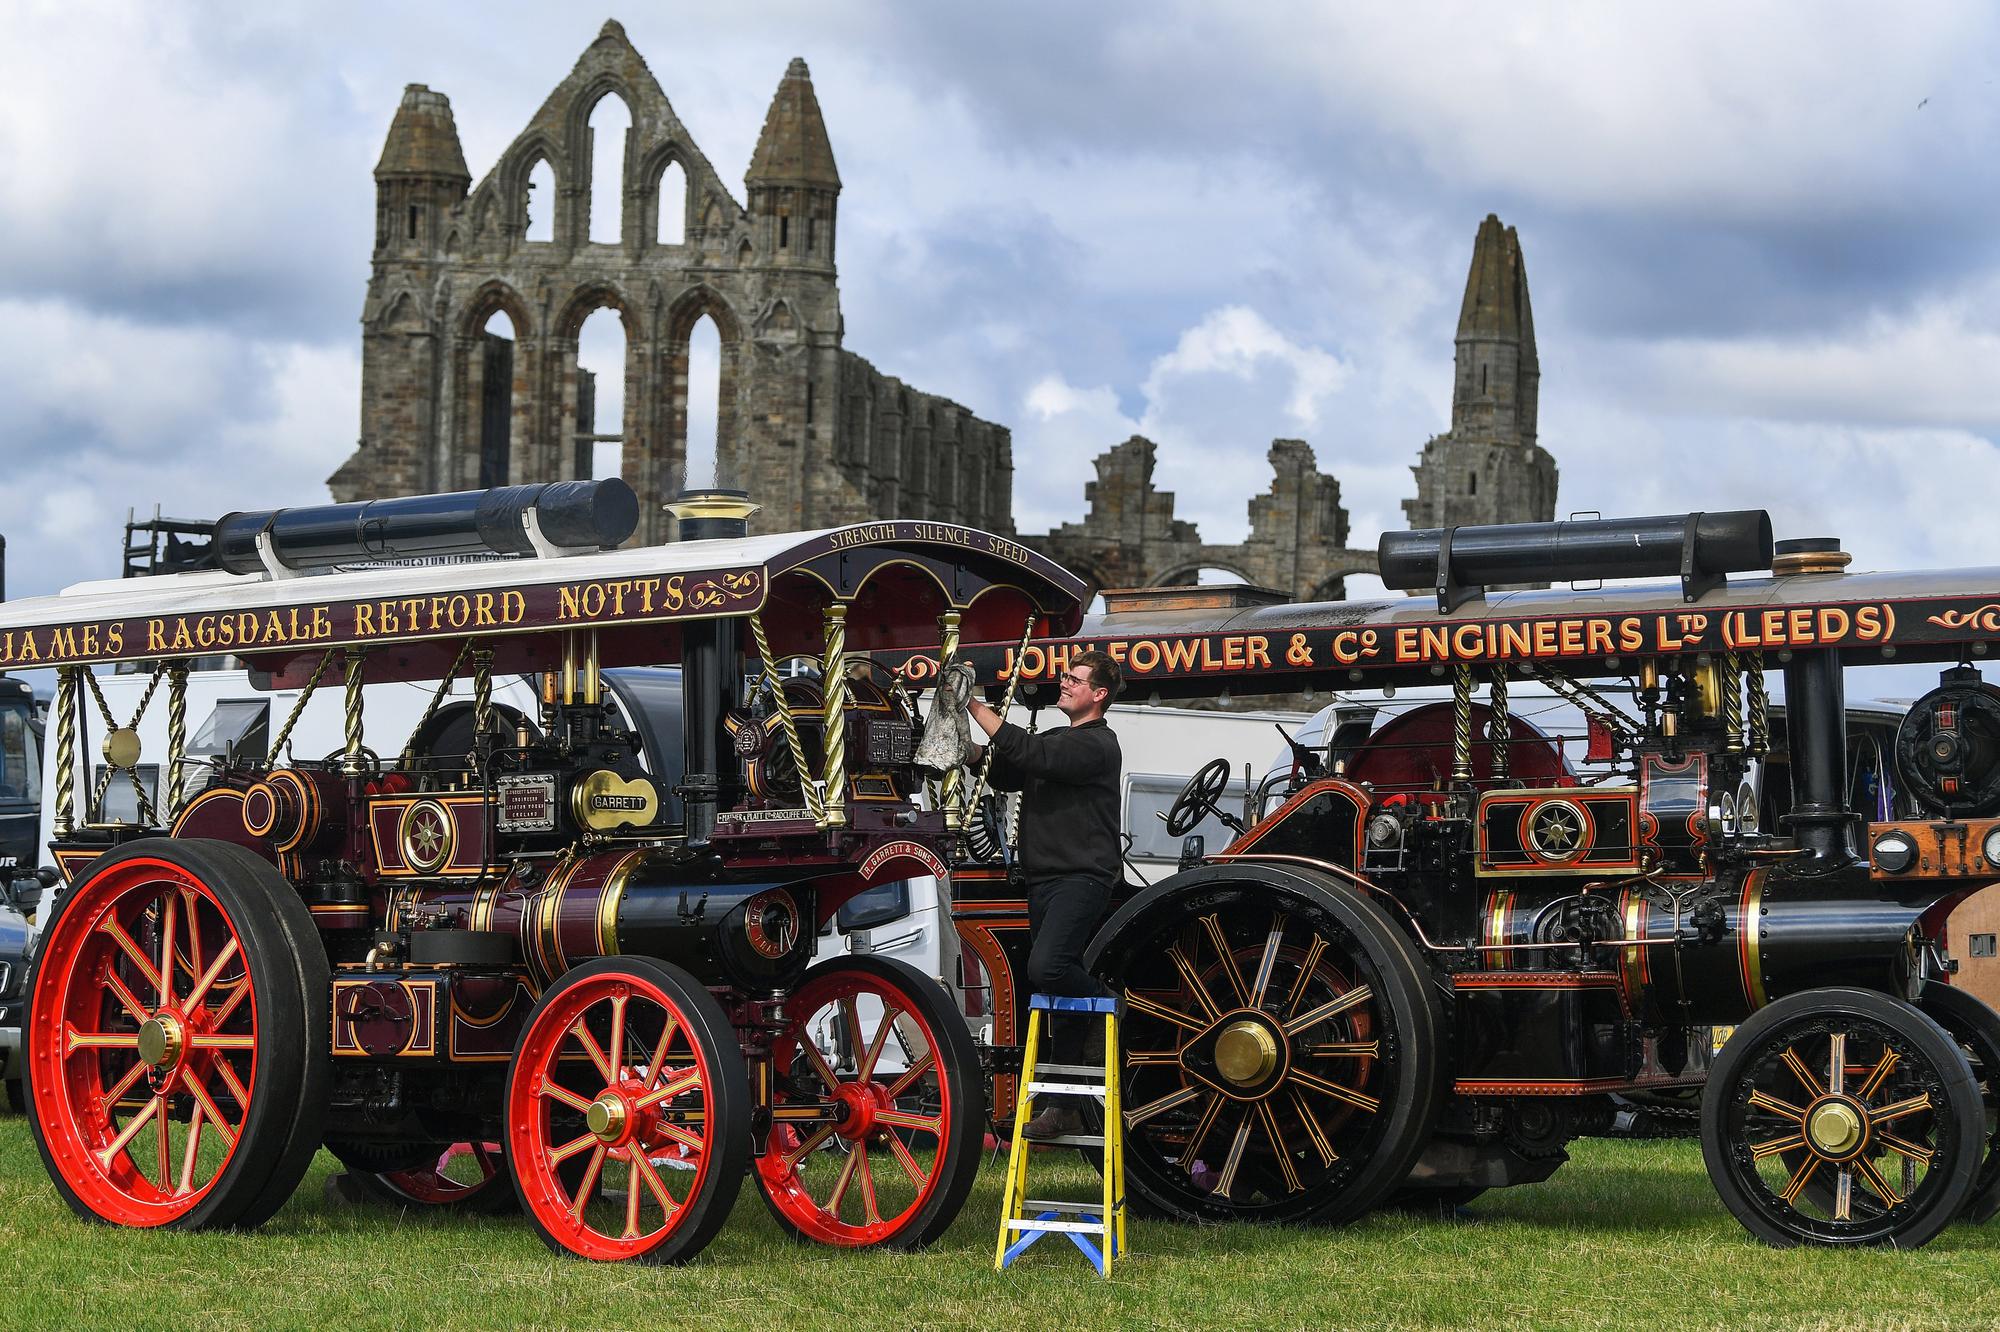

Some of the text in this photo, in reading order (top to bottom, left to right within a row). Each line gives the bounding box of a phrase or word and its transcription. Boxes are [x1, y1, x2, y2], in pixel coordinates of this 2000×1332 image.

[829, 524, 1029, 564] STRENGTH SILENCE SPEED
[0, 576, 685, 662] JAMES RAGSDALE RETFORD NOTTS
[997, 643, 1095, 681] JOH
[1108, 636, 1272, 673] FOWLER
[1285, 633, 1314, 667] &
[1395, 617, 1644, 663] ENGINEERS
[1721, 604, 1896, 649] (LEEDS)
[595, 796, 644, 809] GARRETT
[871, 844, 903, 866] GARRETT
[905, 844, 911, 853] &
[913, 846, 932, 863] SONS
